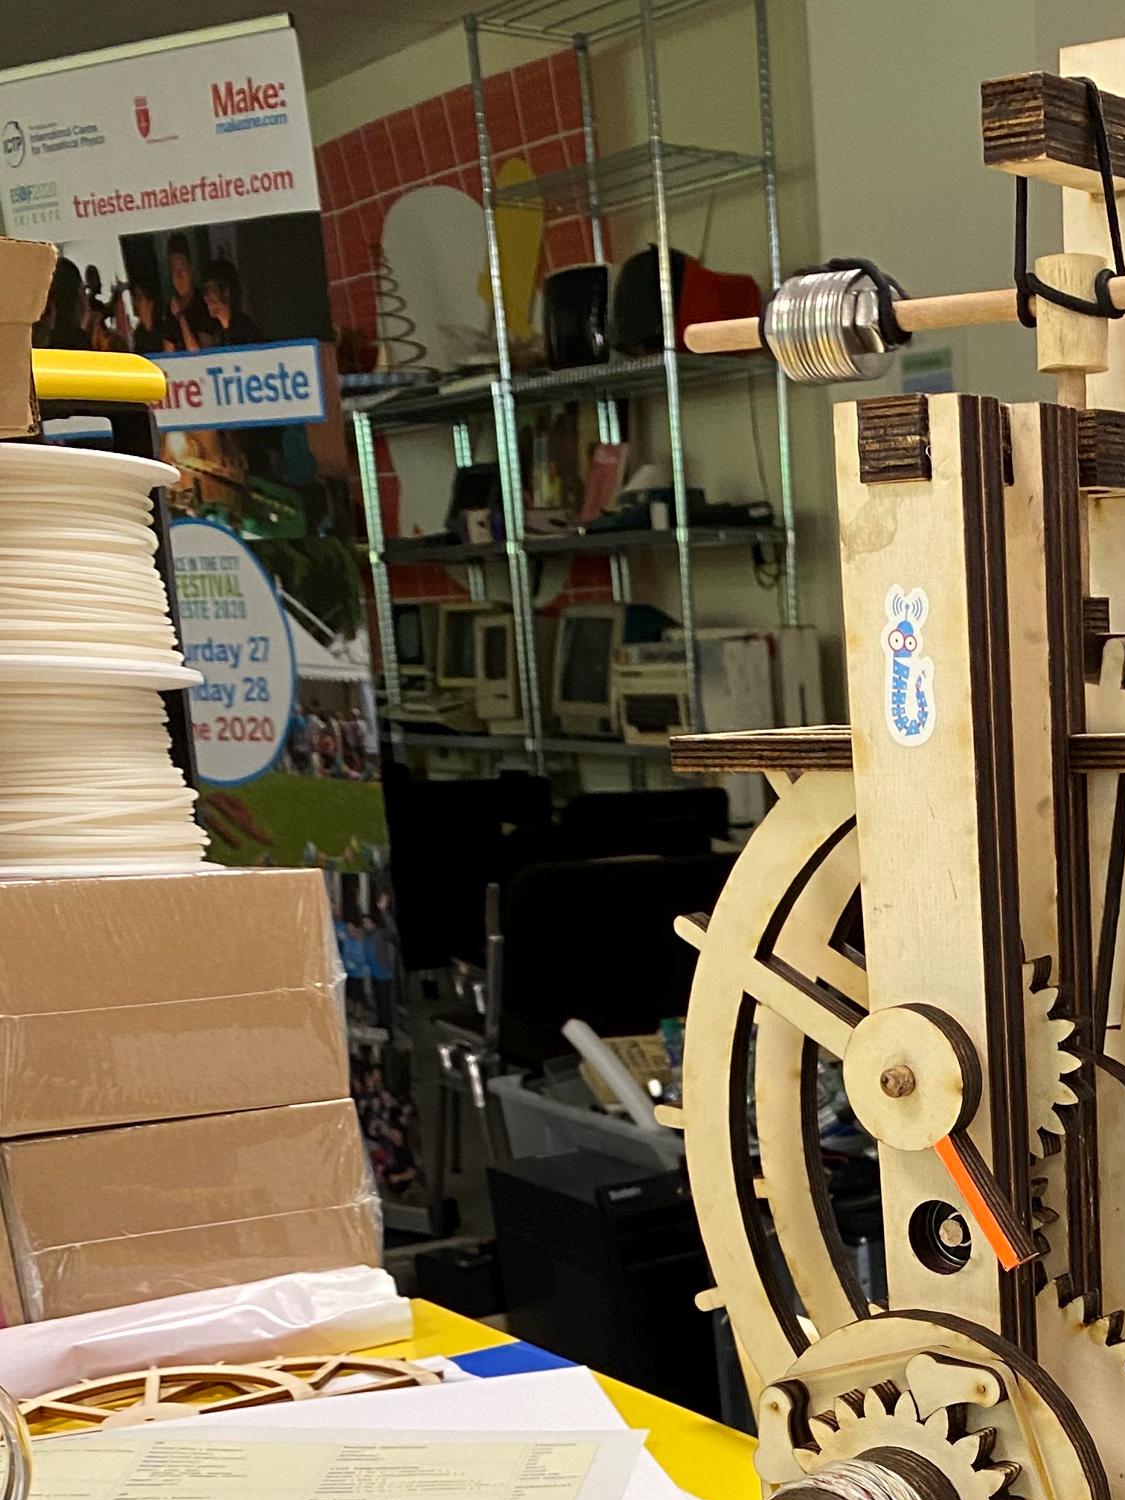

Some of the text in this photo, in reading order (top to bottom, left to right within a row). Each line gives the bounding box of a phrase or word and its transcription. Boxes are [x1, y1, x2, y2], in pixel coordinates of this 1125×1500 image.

[211, 76, 287, 118] Make:
[74, 169, 295, 218] trieste.makerfaire.com
[207, 362, 310, 406] Trieste
[185, 636, 270, 669] urday 27
[243, 676, 270, 701] 28
[215, 715, 275, 743] 2020
